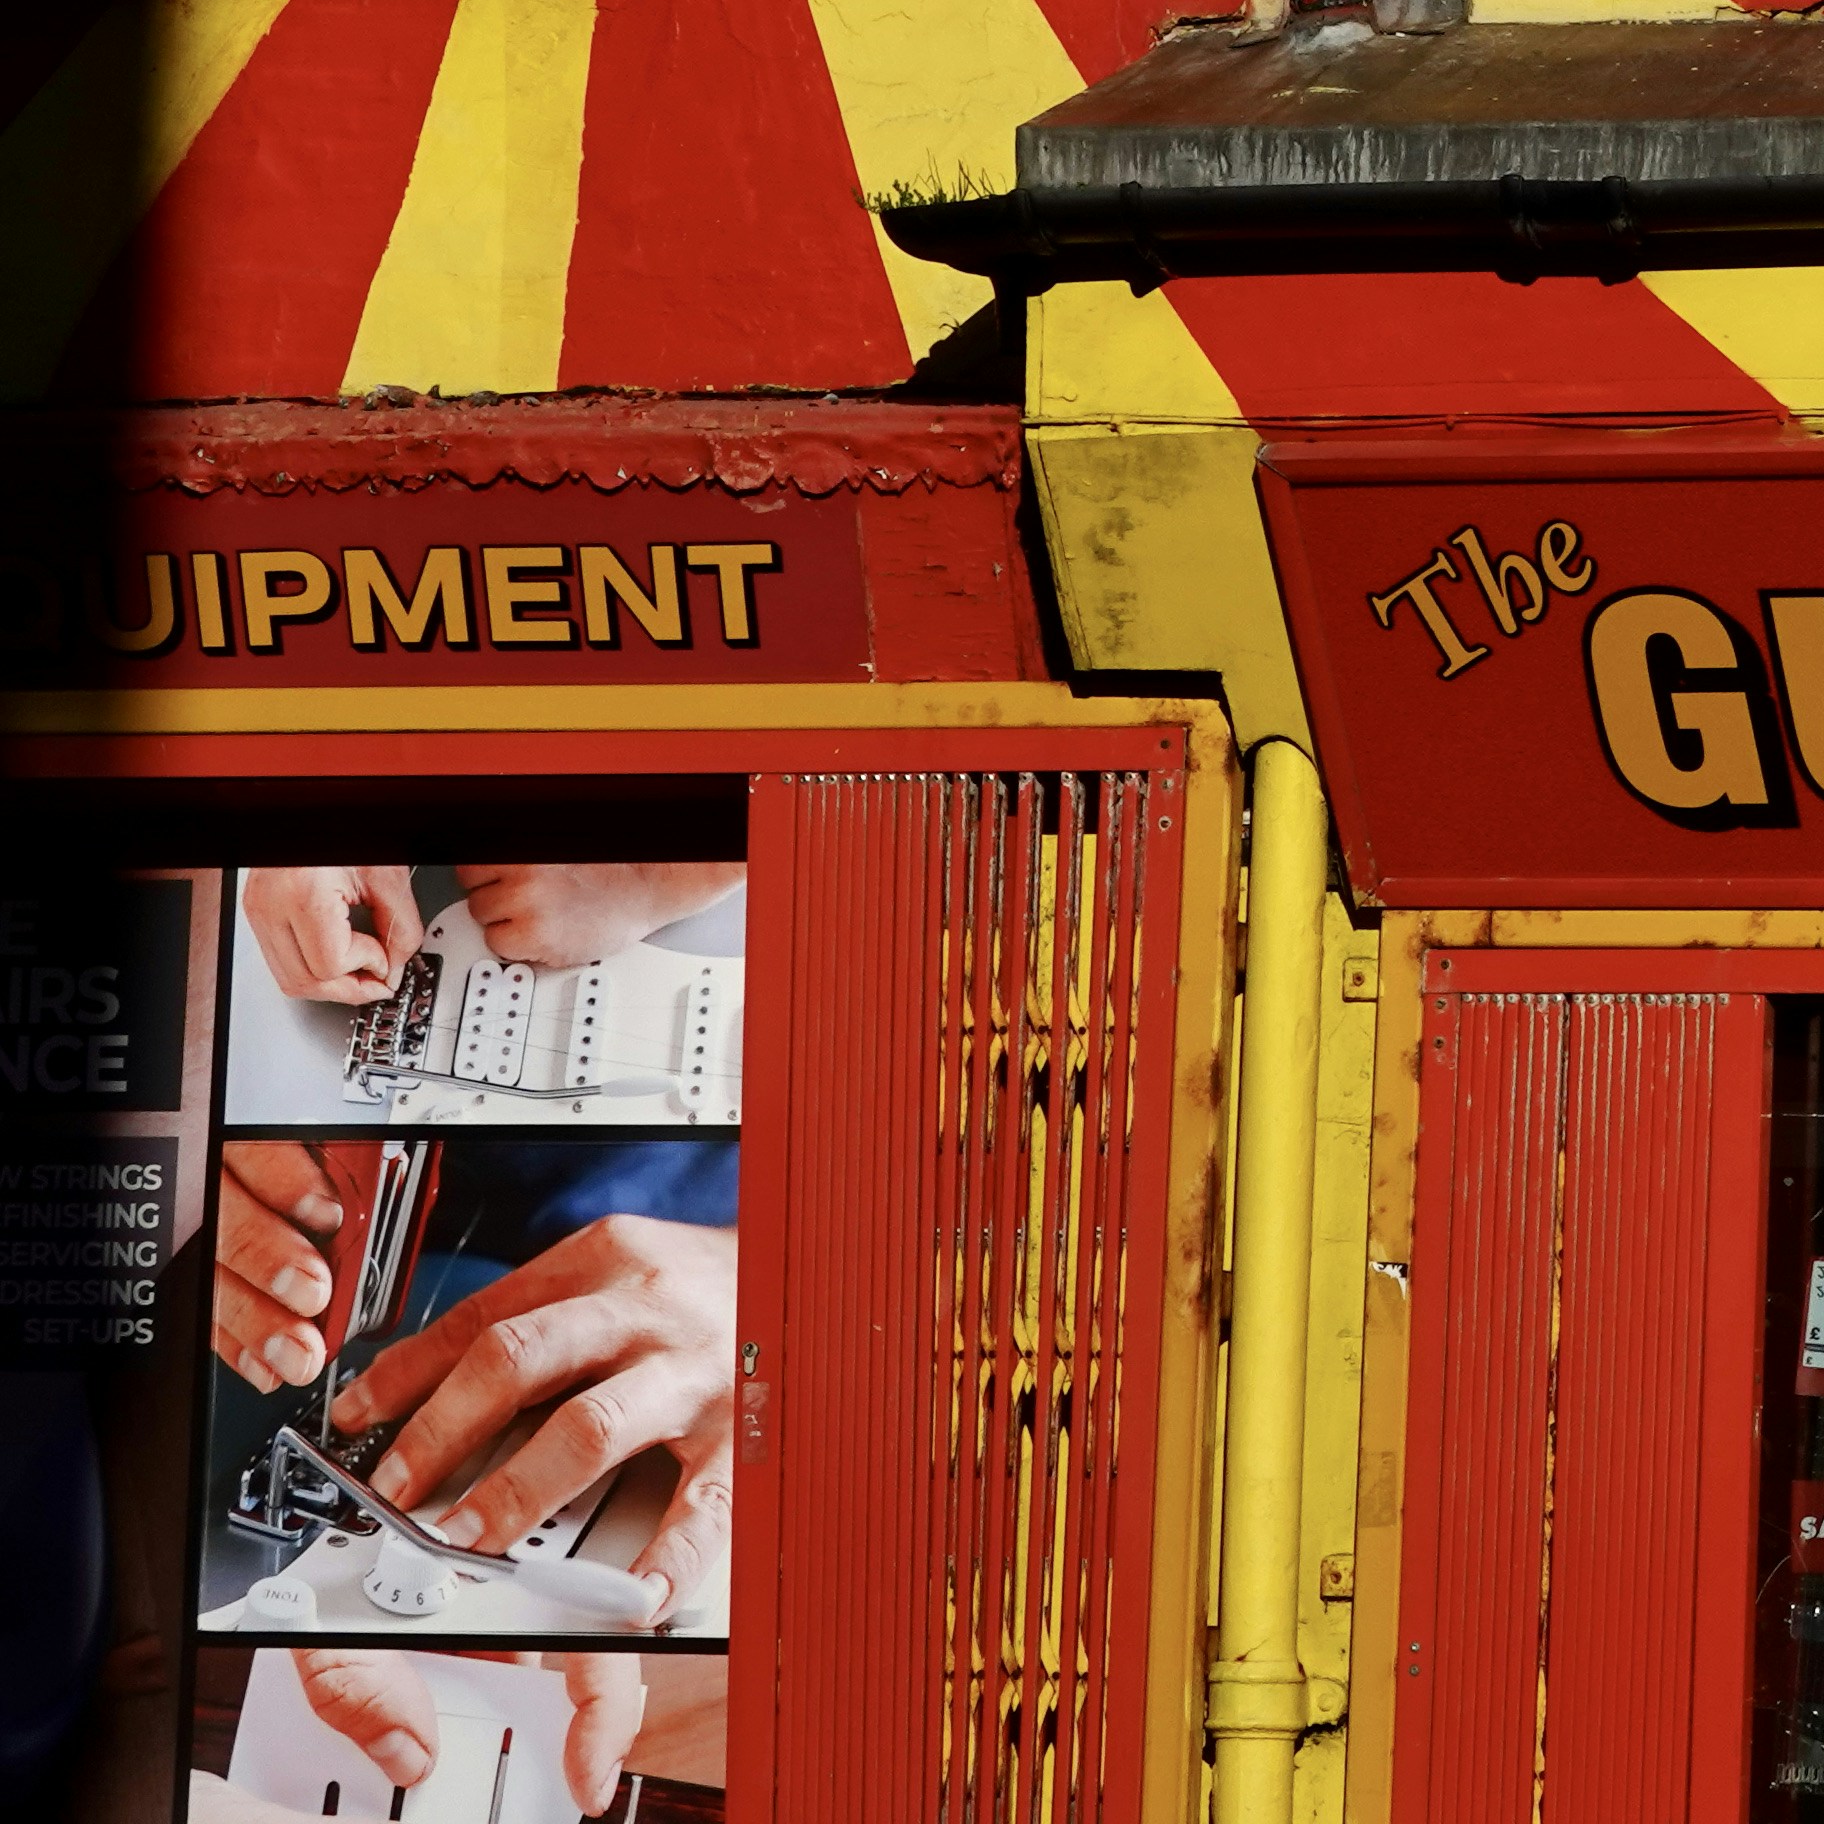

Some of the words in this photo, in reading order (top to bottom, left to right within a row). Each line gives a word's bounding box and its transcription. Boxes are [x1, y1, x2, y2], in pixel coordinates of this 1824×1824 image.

[0, 542, 781, 654] UIPMENT
[1368, 519, 1597, 680] The
[30, 1163, 163, 1190] STRINGS
[0, 1202, 160, 1229] FINISHING
[23, 1317, 155, 1345] SET-UPS
[1809, 1327, 1821, 1340] £
